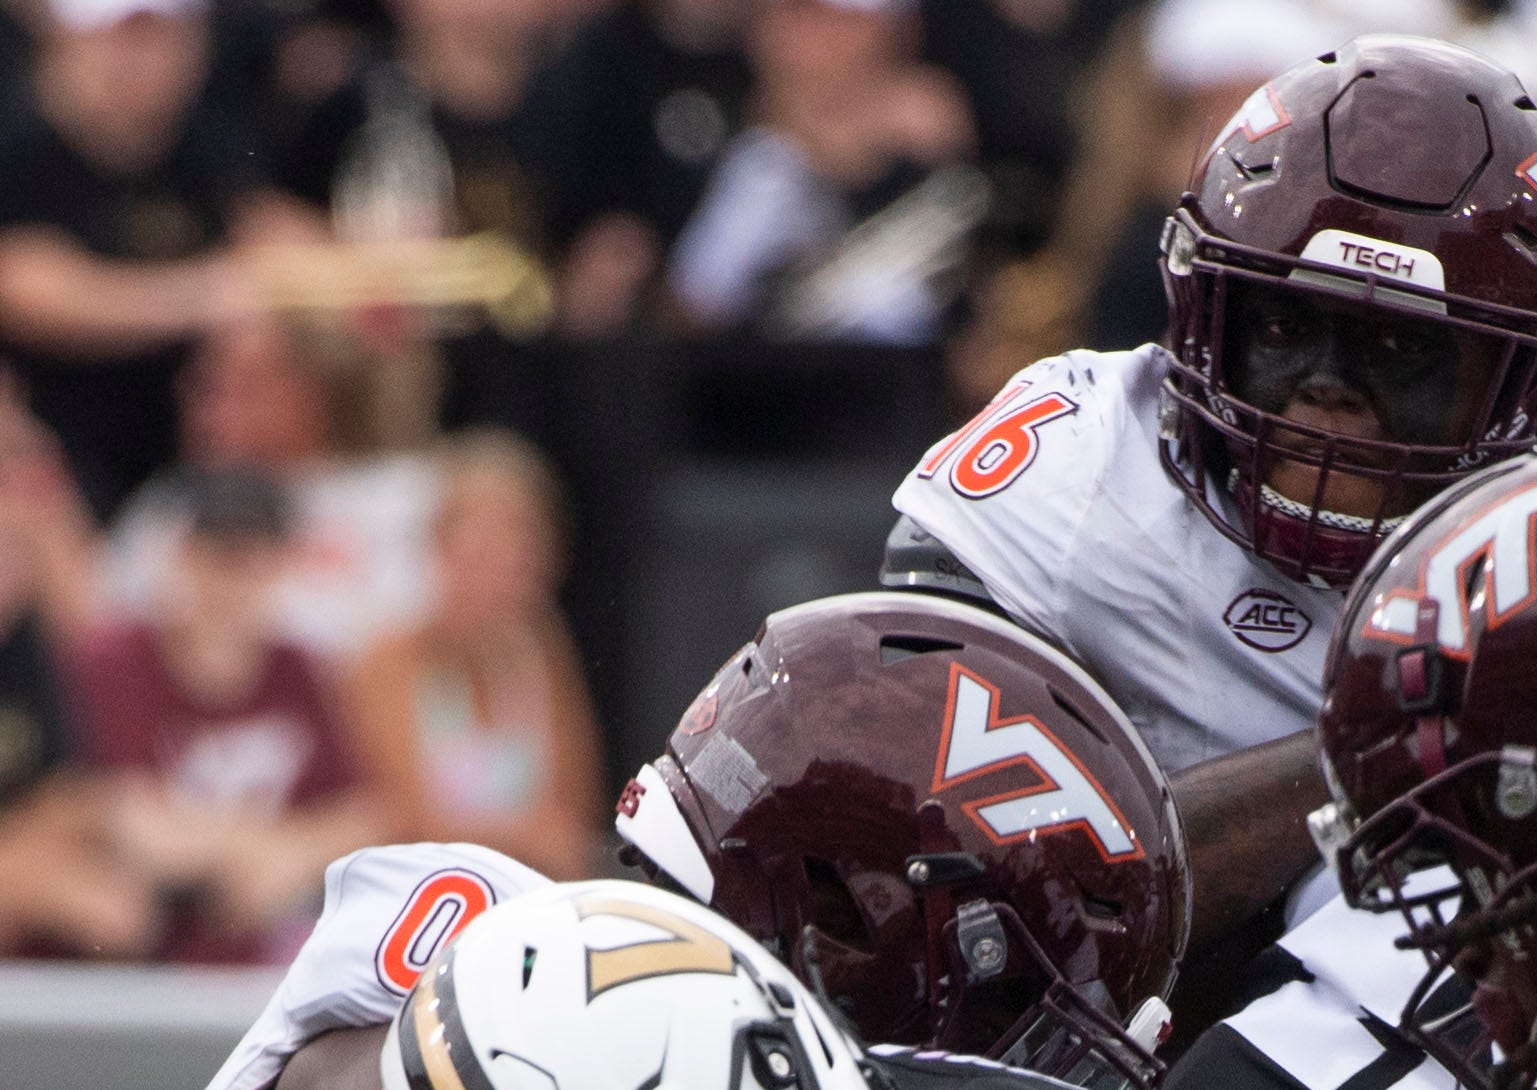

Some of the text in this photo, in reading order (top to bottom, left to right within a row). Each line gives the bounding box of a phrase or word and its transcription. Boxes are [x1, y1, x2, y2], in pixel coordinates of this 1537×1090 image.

[1339, 241, 1415, 278] TECH
[917, 380, 1079, 500] 16
[1237, 603, 1296, 628] ACC
